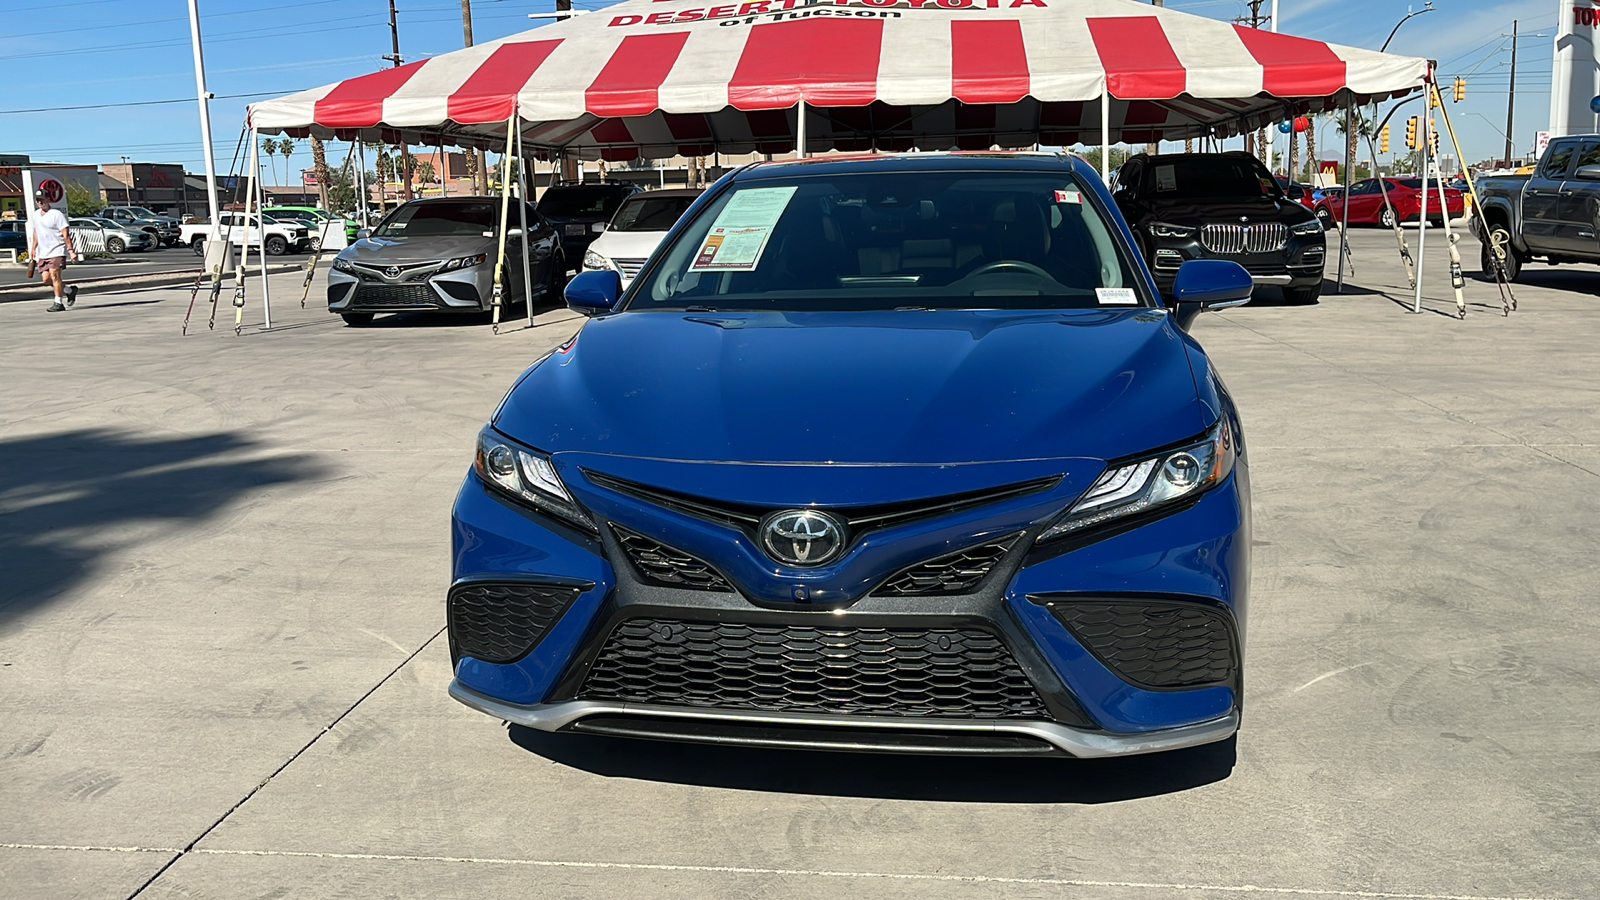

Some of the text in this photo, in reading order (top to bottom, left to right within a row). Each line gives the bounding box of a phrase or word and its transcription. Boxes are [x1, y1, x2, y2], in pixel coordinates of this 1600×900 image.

[607, 0, 797, 27] DESERT
[719, 9, 901, 27] of Tucson
